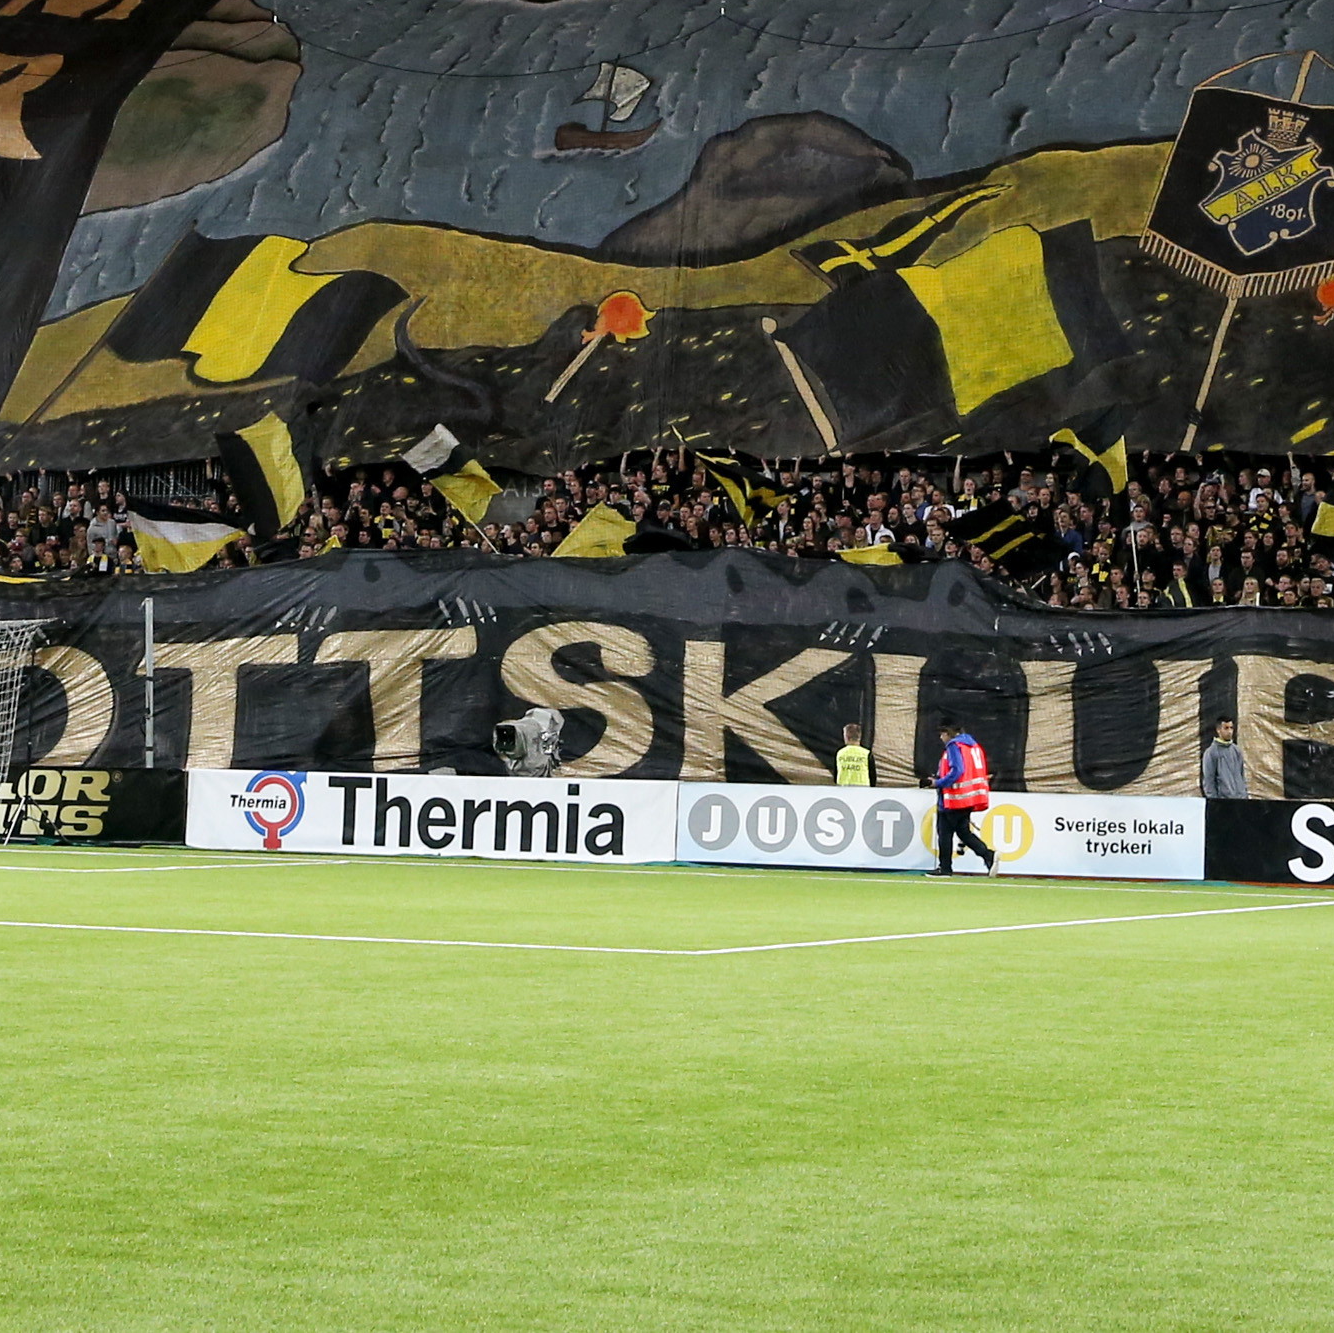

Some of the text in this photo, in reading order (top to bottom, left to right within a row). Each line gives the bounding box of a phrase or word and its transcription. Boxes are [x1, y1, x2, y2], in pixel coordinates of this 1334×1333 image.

[503, 477, 547, 497] A13
[230, 793, 287, 811] Thermia
[328, 775, 625, 857] Thermia
[700, 802, 903, 850] JUST
[1054, 816, 1185, 837] Sveriges lokala
[1085, 837, 1153, 856] tryckeri
